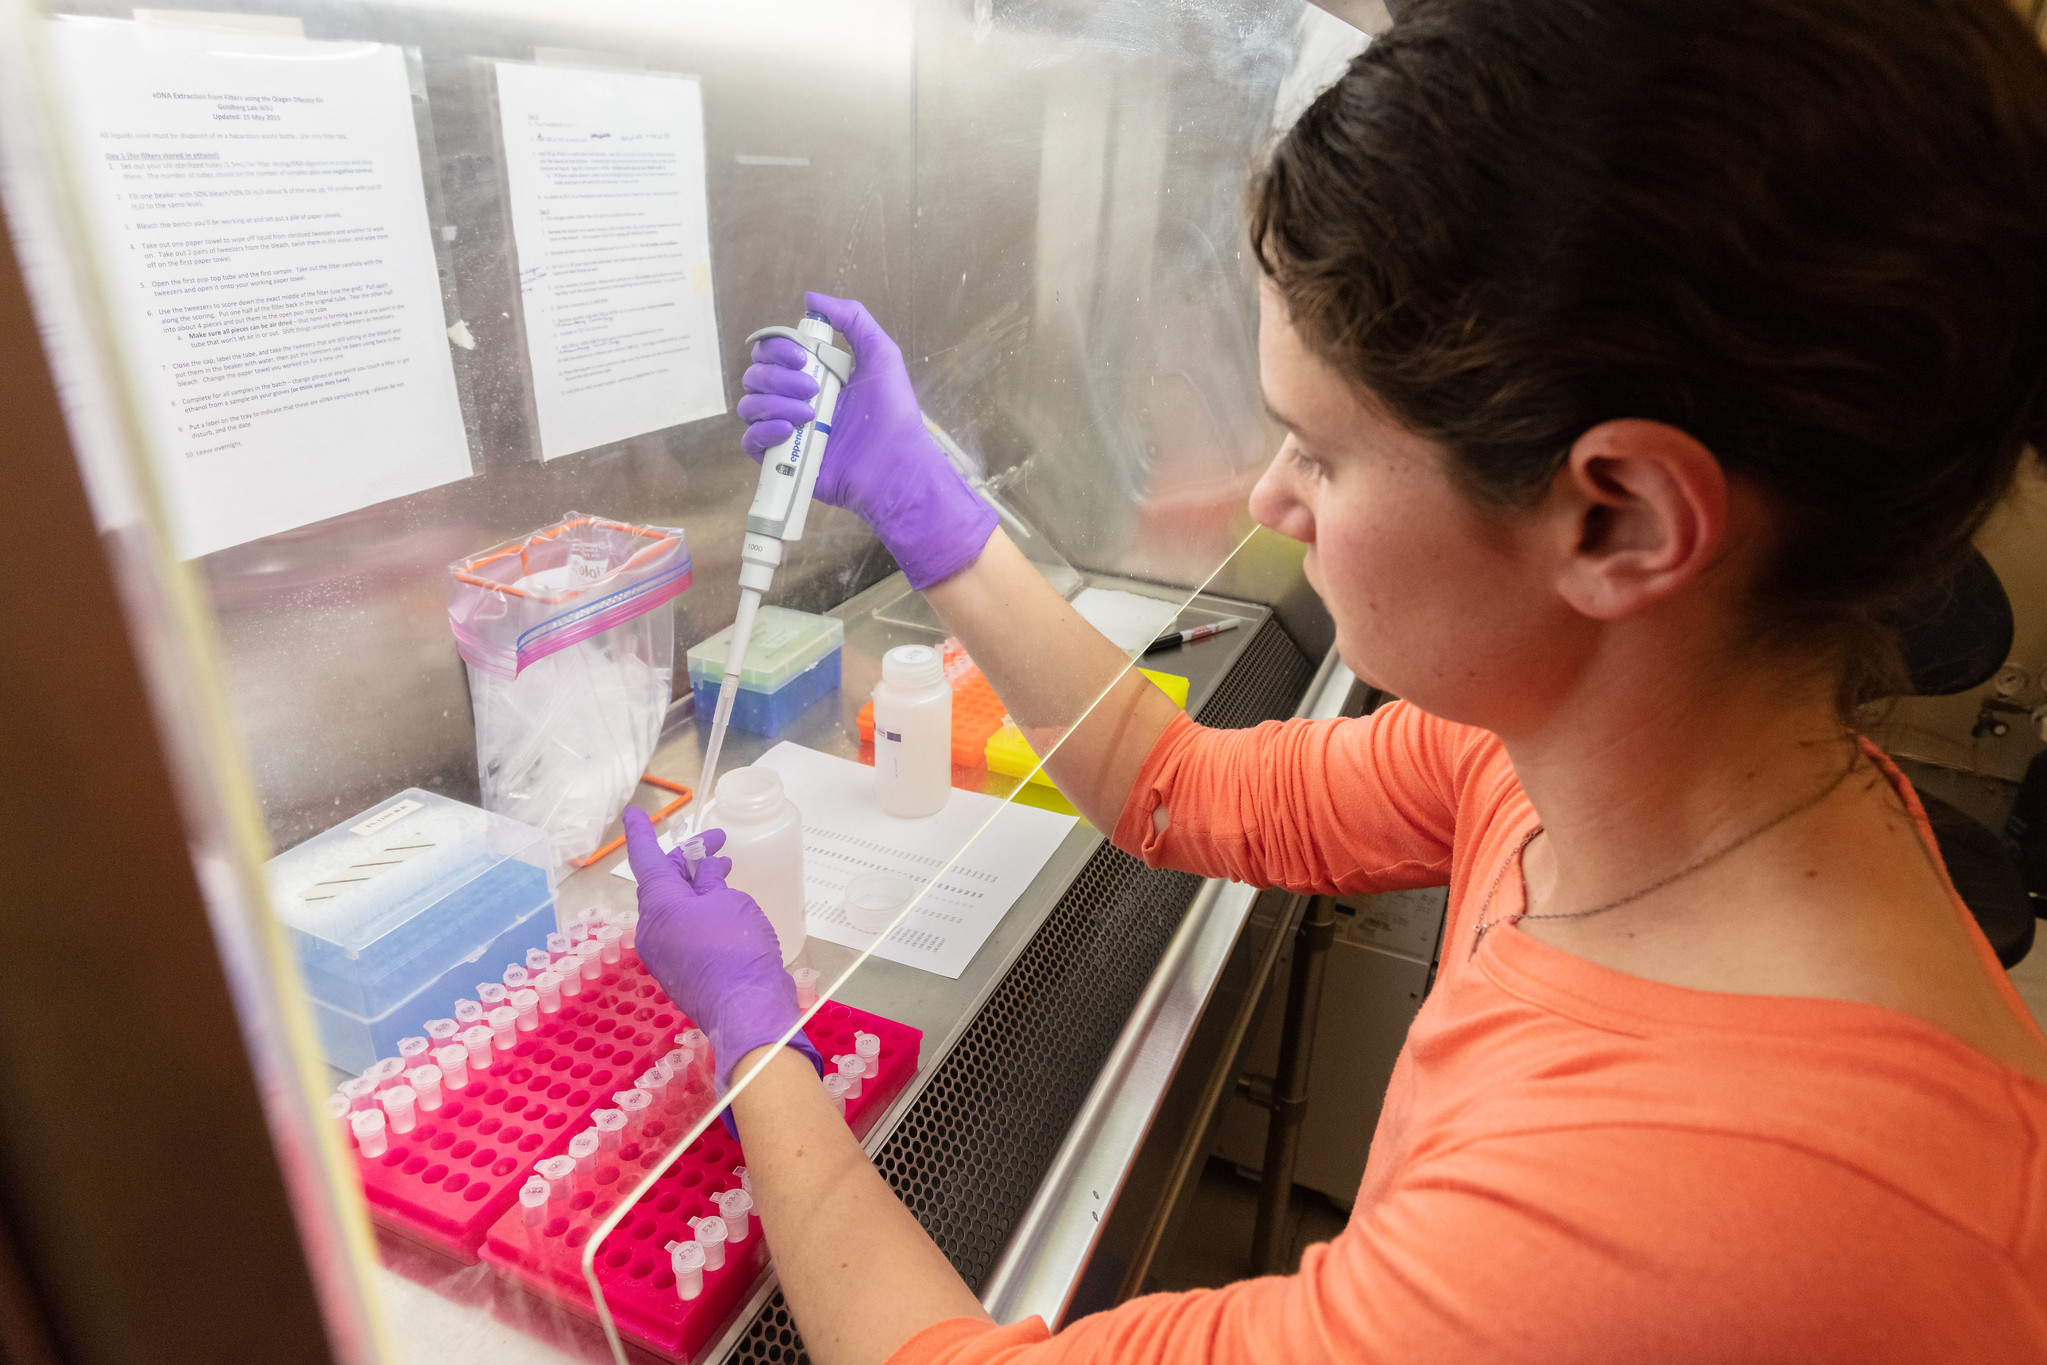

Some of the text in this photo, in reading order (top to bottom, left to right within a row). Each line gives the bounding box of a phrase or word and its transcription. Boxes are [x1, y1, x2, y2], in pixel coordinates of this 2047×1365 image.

[218, 104, 245, 112] Goldberg
[193, 248, 208, 256] pairs
[196, 275, 220, 284] pop-top
[184, 304, 212, 312] tweezers
[203, 321, 222, 329] pieces
[235, 317, 244, 325] put
[231, 326, 249, 334] pieces
[292, 342, 315, 350] tweezers
[174, 371, 186, 380] put
[309, 347, 331, 356] tweezers
[202, 374, 224, 382] Change
[237, 369, 252, 378] paper
[254, 366, 270, 374] towel
[282, 360, 301, 369] worked
[181, 394, 211, 404] Complete
[231, 387, 253, 395] samples
[271, 380, 286, 388] batch
[184, 403, 206, 413] ethanol
[229, 396, 250, 404] sample
[272, 388, 290, 398] gloves
[299, 383, 312, 391] think
[205, 418, 219, 426] label
[260, 406, 281, 416] indicate
[748, 543, 763, 552] 1000
